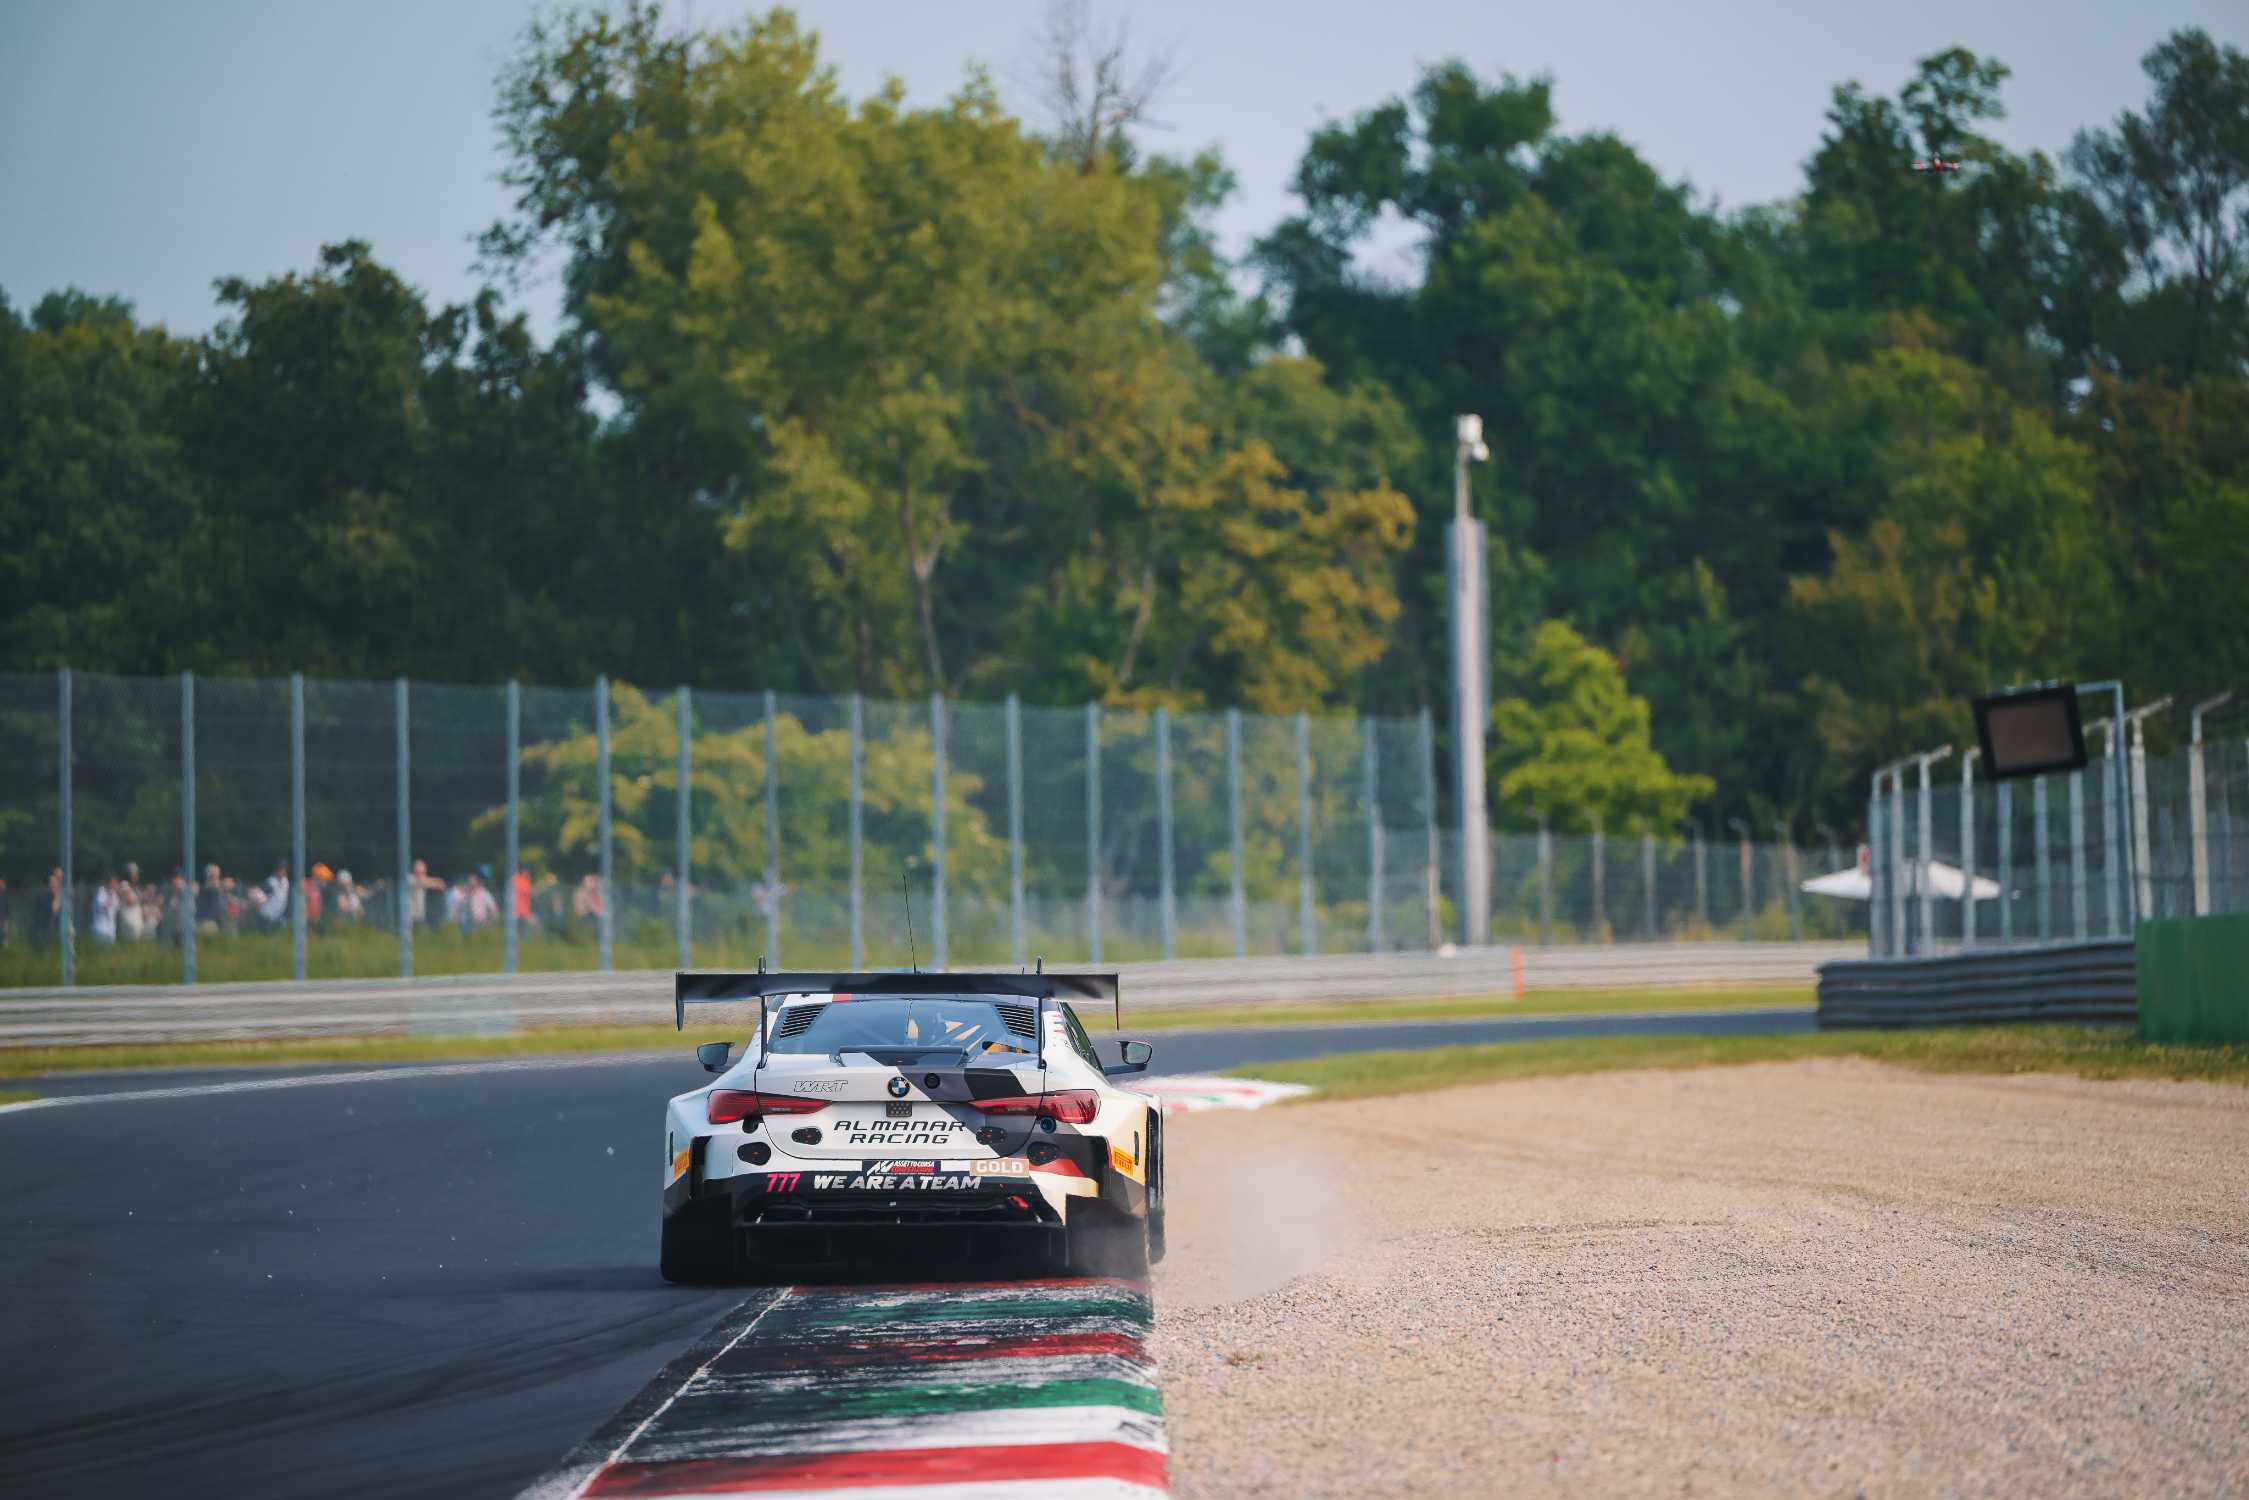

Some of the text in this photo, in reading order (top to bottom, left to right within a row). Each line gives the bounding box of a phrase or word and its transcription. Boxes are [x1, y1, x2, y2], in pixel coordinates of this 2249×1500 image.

[794, 1079, 848, 1093] WRT
[834, 1120, 966, 1131] ALMANAR
[849, 1133, 948, 1144] RACING
[975, 1160, 1024, 1174] GOLD
[766, 1172, 801, 1193] 777
[813, 1174, 982, 1190] WE ARE A TEAM
